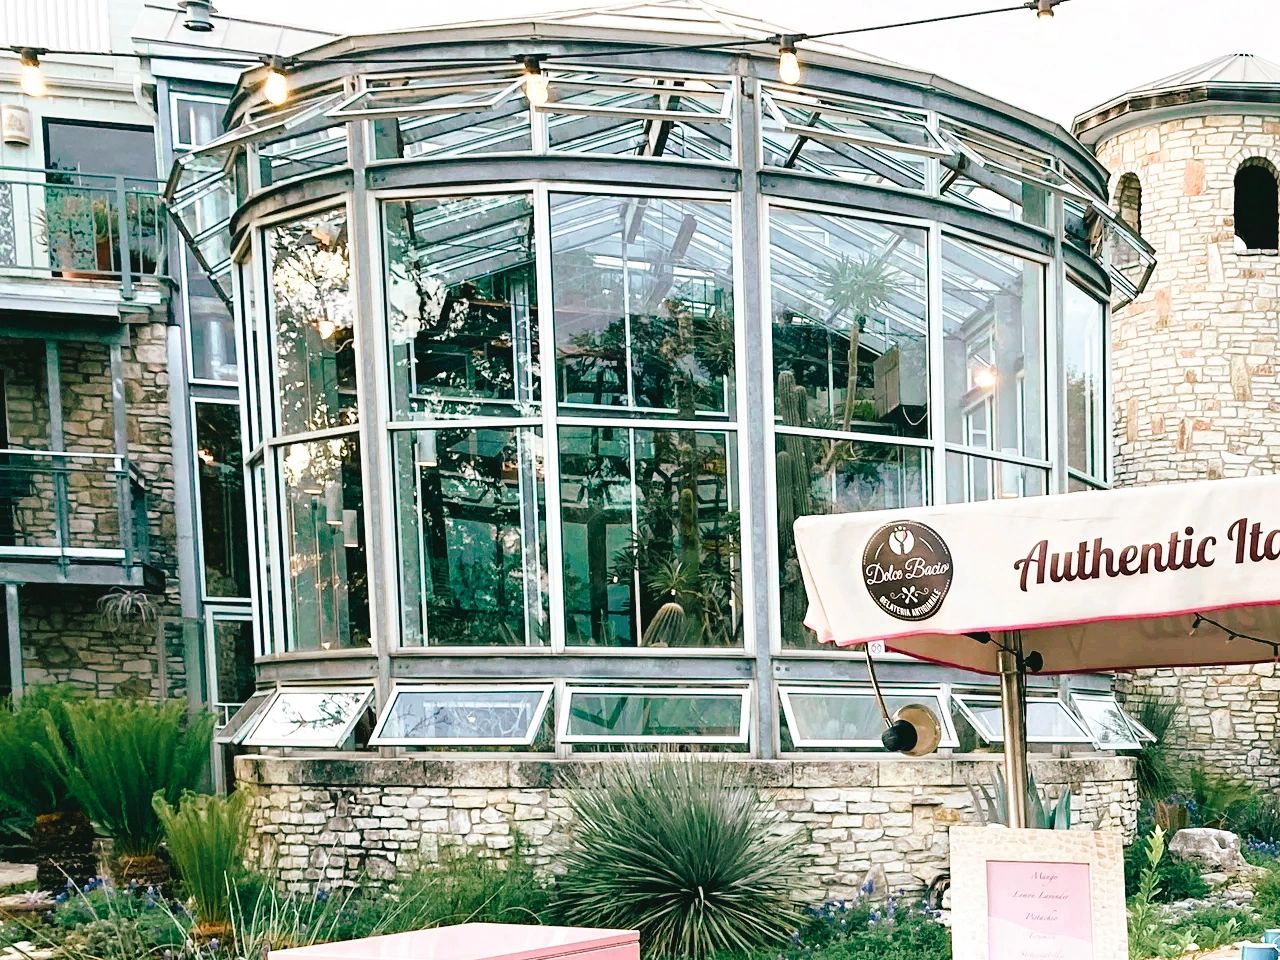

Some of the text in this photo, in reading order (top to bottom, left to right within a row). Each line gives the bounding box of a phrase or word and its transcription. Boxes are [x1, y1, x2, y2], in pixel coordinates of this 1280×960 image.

[866, 557, 950, 585] Dolce Bacio
[1014, 526, 1216, 592] Authentic
[879, 596, 911, 616] GELATERIA
